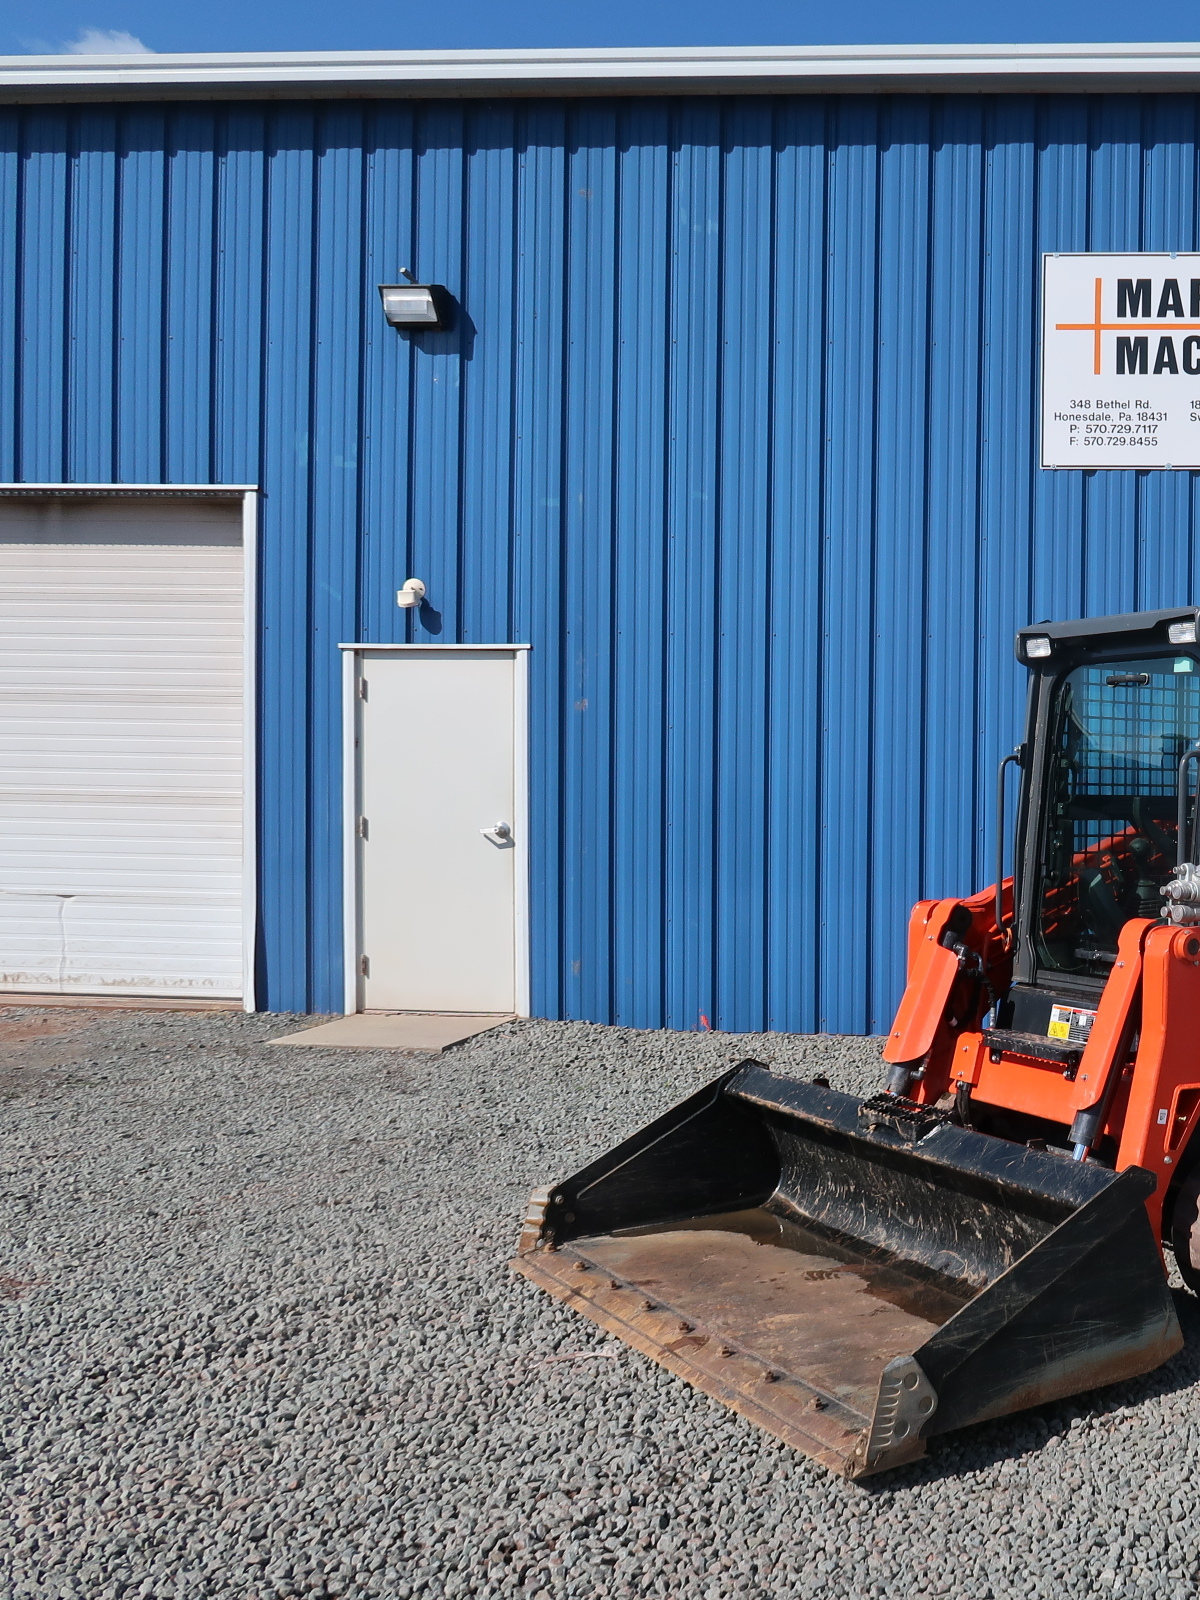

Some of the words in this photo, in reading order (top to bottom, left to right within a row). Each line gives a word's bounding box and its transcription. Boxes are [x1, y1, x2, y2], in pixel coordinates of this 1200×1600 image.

[1069, 399, 1091, 409] 348
[1096, 399, 1130, 409] Bethel
[1135, 399, 1152, 409] Rd.
[1054, 411, 1114, 422] Honesdale,
[1118, 412, 1134, 421] Pa.
[1136, 412, 1168, 421] 18431
[1069, 424, 1080, 434] P:
[1085, 424, 1159, 434] 570.729.7117
[1069, 436, 1079, 446] F:
[1084, 436, 1158, 446] 570.729.8455
